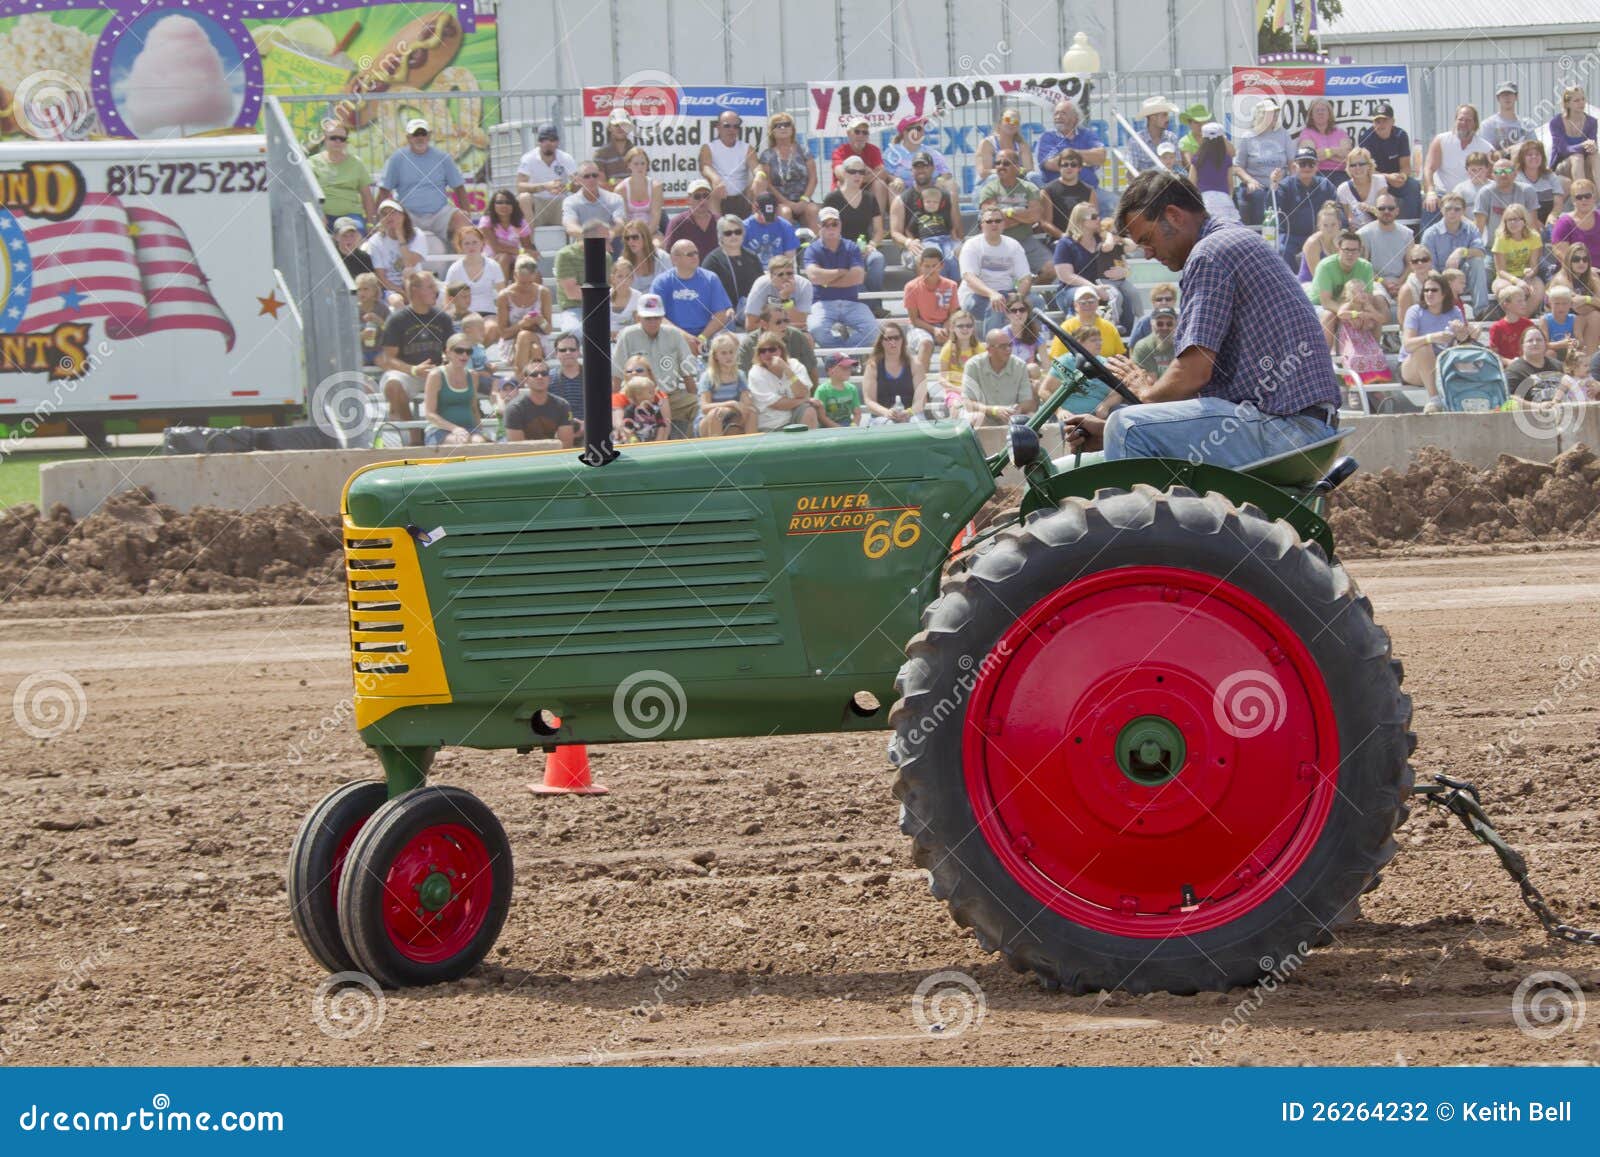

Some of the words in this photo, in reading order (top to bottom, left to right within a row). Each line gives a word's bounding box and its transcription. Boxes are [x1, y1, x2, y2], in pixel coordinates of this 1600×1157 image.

[1241, 73, 1315, 88] Budweiser
[810, 84, 900, 130] Y100
[838, 113, 895, 126] CONTRY
[591, 119, 701, 147] Bkstead
[651, 153, 697, 172] enlea
[797, 493, 870, 511] OLIVER
[789, 515, 828, 530] ROW
[830, 513, 876, 528] CROP
[863, 509, 922, 560] 66
